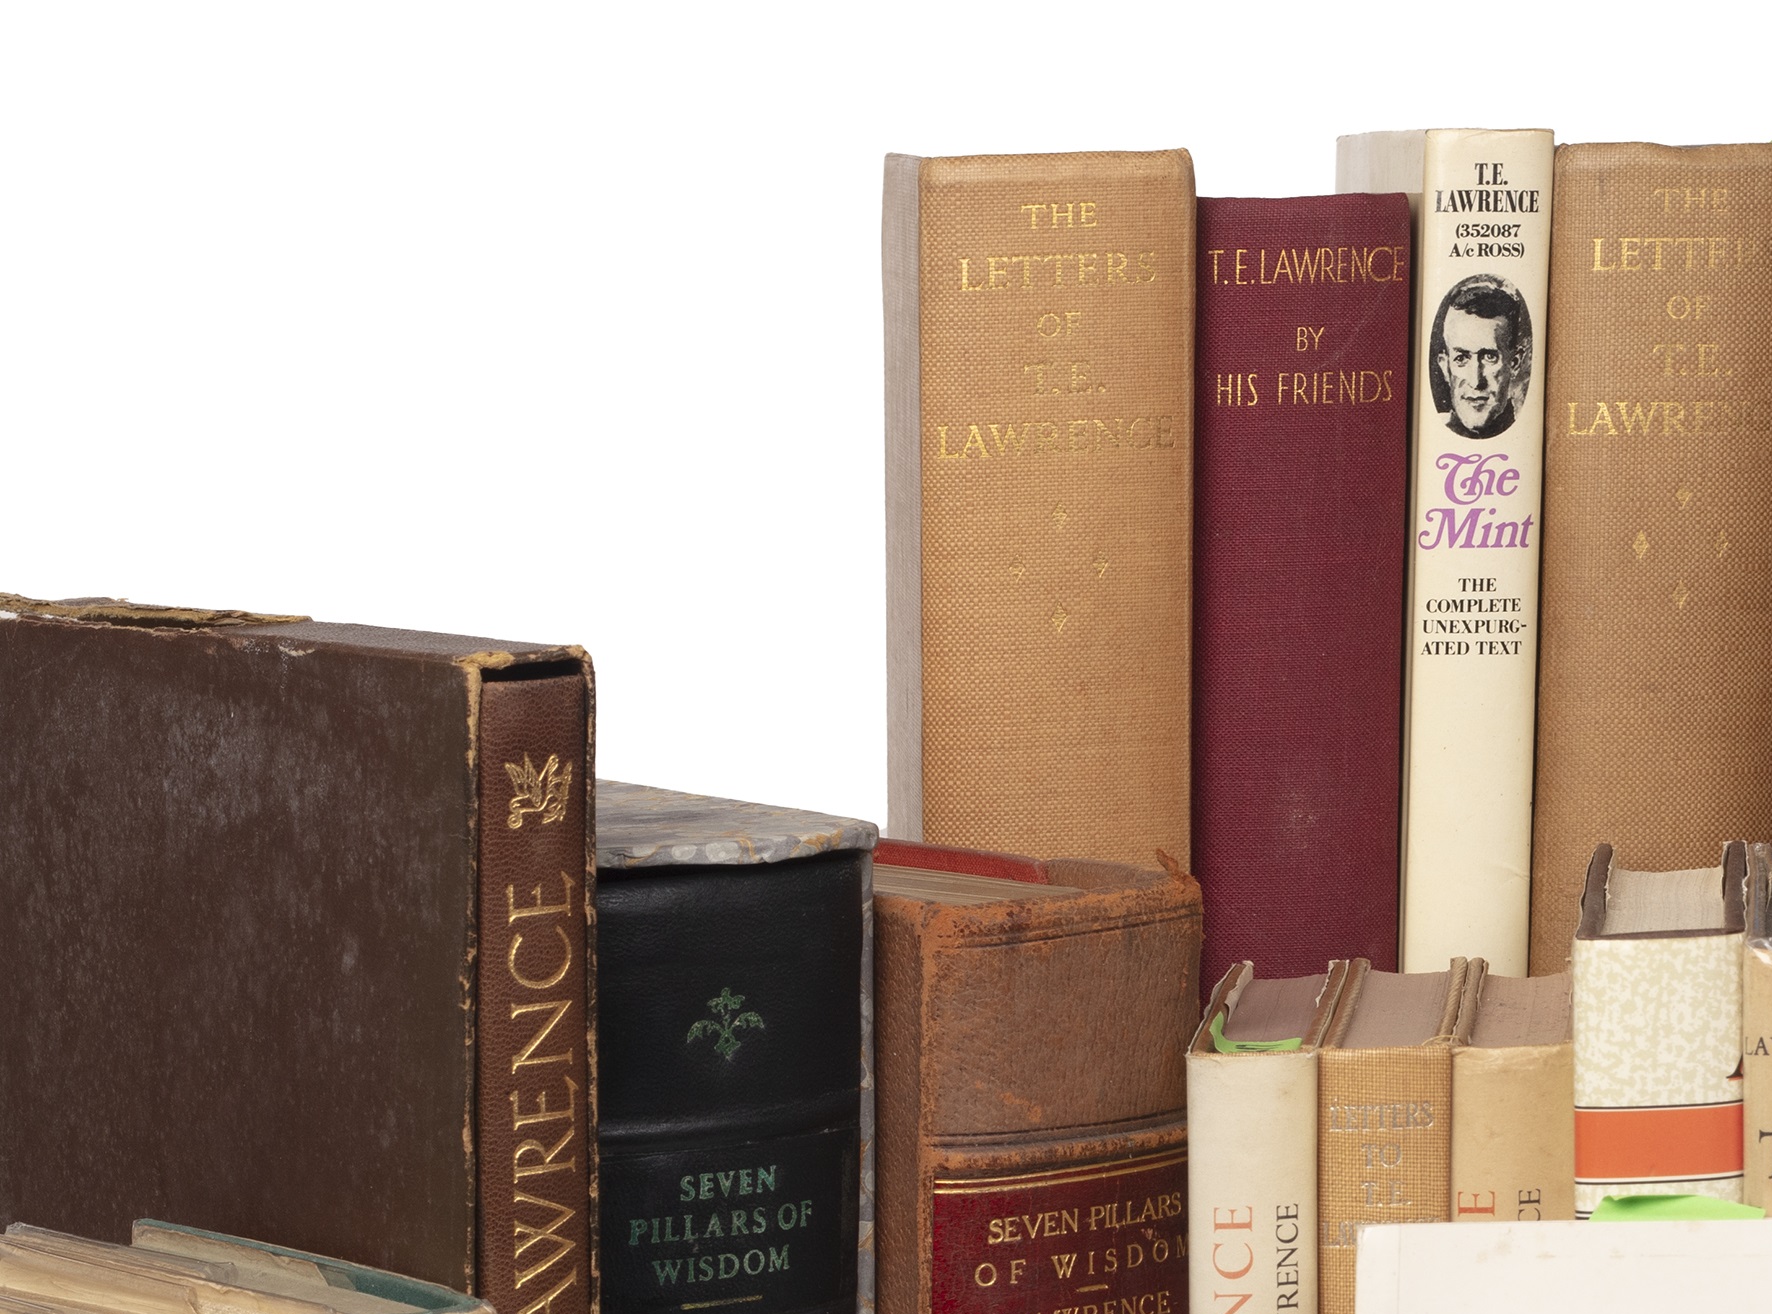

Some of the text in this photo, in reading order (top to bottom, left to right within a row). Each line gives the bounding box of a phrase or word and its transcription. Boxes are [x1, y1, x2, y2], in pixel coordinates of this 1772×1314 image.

[1435, 189, 1539, 213] LAWRENCE
[1654, 187, 1728, 213] THE
[1021, 202, 1098, 229] THE
[1455, 222, 1522, 240] (352087
[1449, 241, 1526, 259] A/c ROSS)
[959, 250, 1158, 292] LETTERS
[1261, 247, 1404, 284] LAWRENCE
[1667, 296, 1710, 320] OF
[1036, 311, 1081, 338] OF
[1296, 327, 1324, 351] BY
[1216, 370, 1393, 407] HIS FRIENDS
[936, 417, 1176, 459] LAWRENCE
[1435, 453, 1520, 505] The
[1418, 508, 1534, 552] Mint
[1457, 577, 1497, 593] THE
[1425, 599, 1521, 615] COMPLETE
[1422, 618, 1527, 636] UNEXPURG-
[1421, 639, 1522, 656] ATED TEXT
[1328, 1100, 1435, 1133] LETTERS
[1361, 1143, 1402, 1169] TO
[680, 1164, 777, 1202] SEVEN
[628, 1199, 813, 1245] PILLARS OF
[987, 1192, 1182, 1245] SEVEN PILLARS
[651, 1244, 791, 1286] WISDOM
[974, 1259, 1027, 1287] OF
